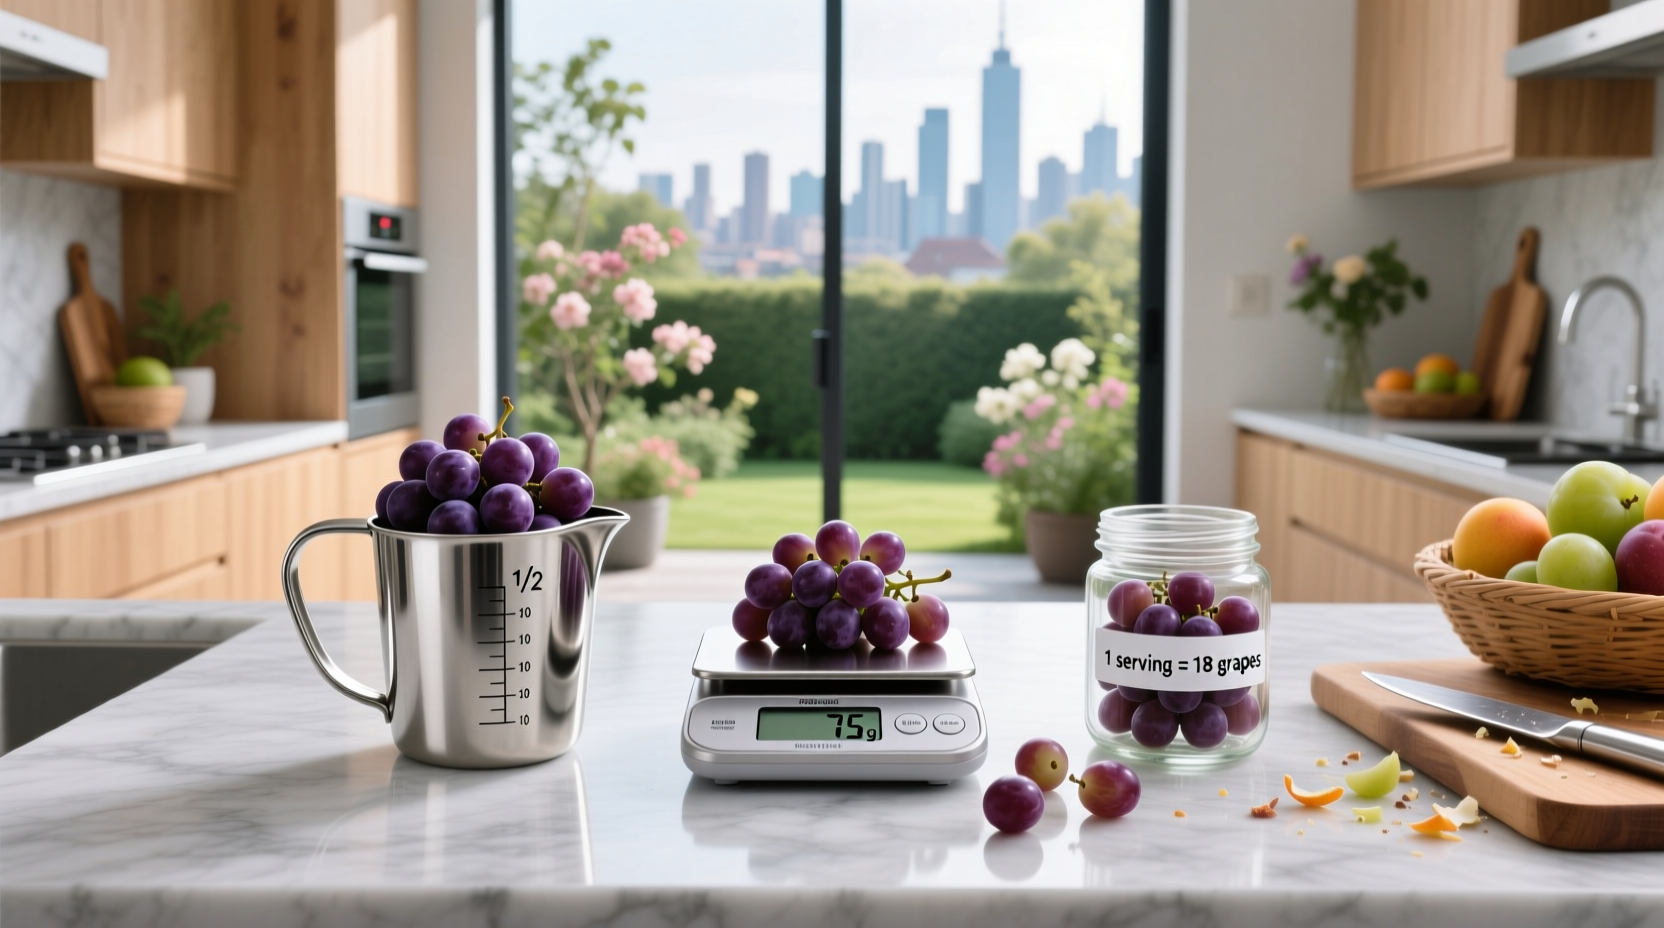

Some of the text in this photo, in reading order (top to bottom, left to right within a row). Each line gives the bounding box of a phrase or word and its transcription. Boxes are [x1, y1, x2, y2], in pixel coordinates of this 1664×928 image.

[512, 565, 543, 593] 1/2
[519, 607, 531, 618] 10
[519, 633, 531, 645] 10
[519, 661, 531, 673] 10
[1105, 649, 1111, 665] 1
[1116, 654, 1172, 677] serving
[1193, 655, 1213, 673] 18
[1217, 653, 1261, 676] grapes
[519, 688, 530, 699] 10
[519, 714, 530, 726] 10
